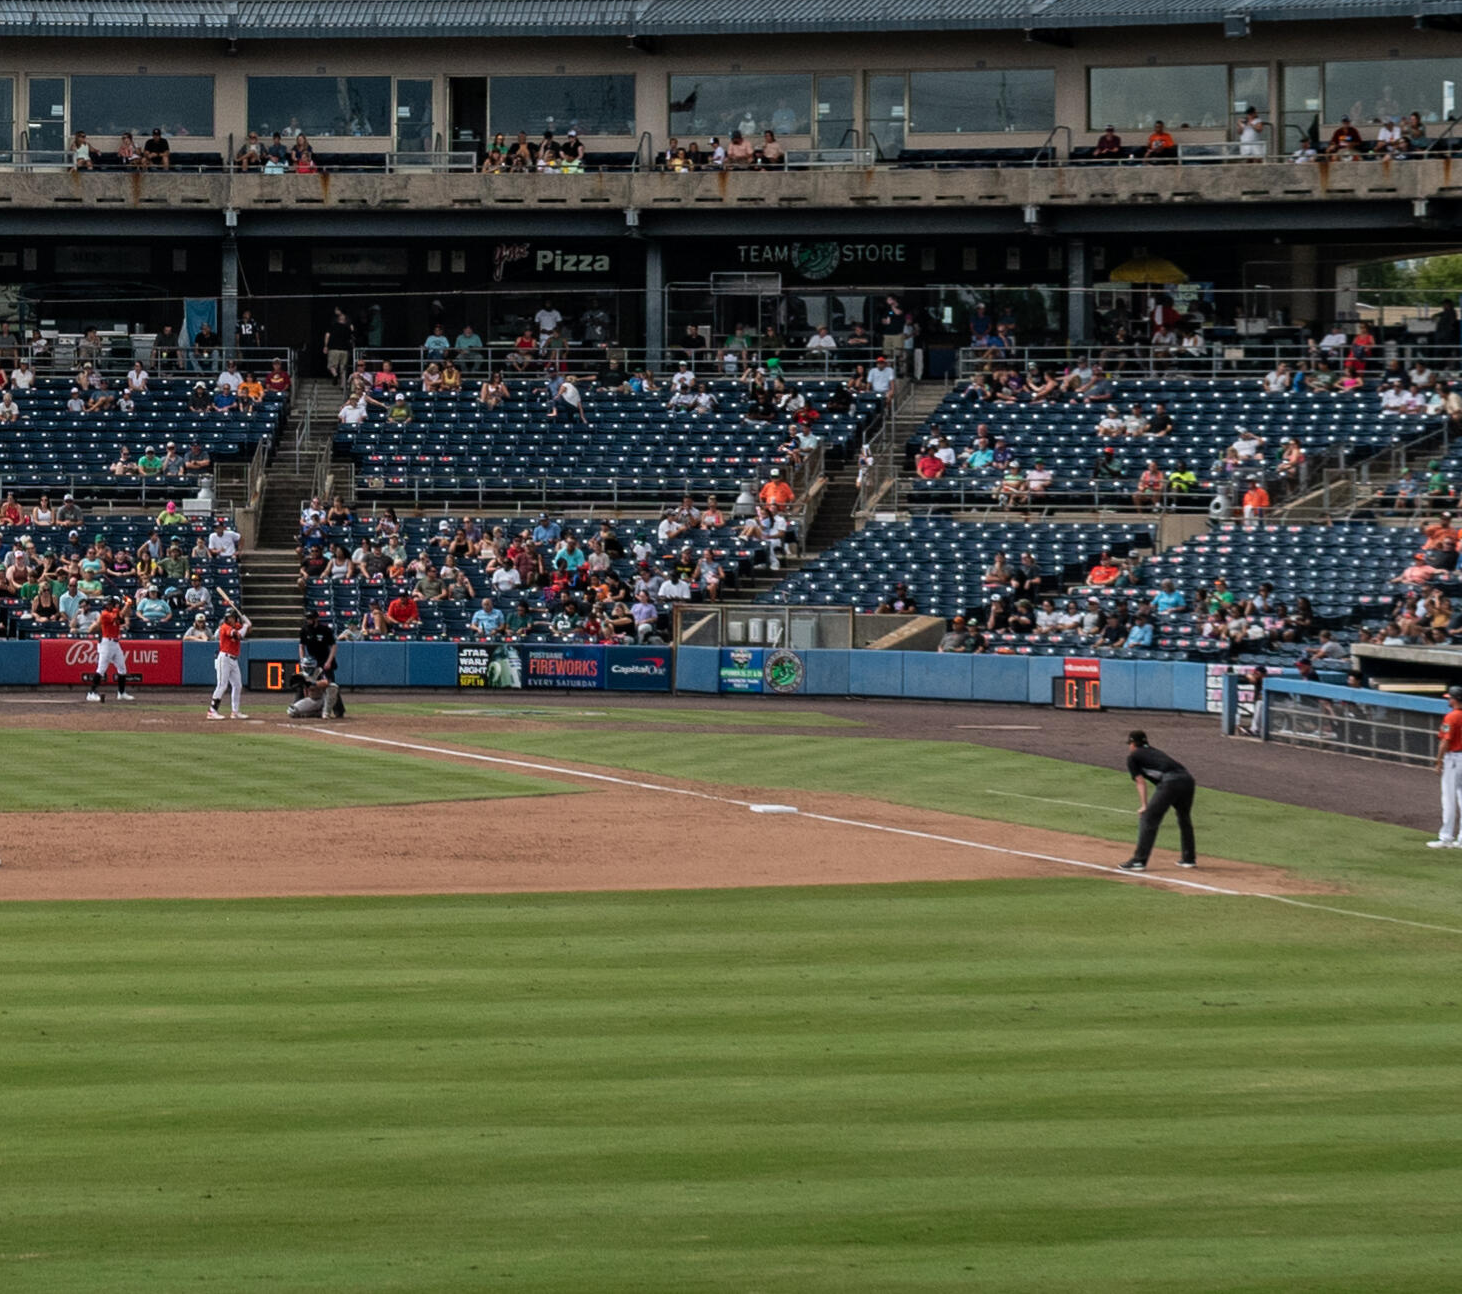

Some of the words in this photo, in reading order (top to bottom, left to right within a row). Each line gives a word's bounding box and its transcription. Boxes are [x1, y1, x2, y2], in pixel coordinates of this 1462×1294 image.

[738, 244, 789, 263] TEAM
[842, 244, 906, 263] STORE
[535, 249, 611, 273] Pizza
[241, 324, 253, 335] 12
[133, 650, 158, 663] LIVE
[459, 648, 489, 657] STAR
[459, 657, 488, 666] WARS
[458, 665, 487, 674] NIGHT
[529, 659, 598, 677] FIREWORKS
[528, 678, 553, 686] EVERY
[556, 679, 597, 687] SATURDAY
